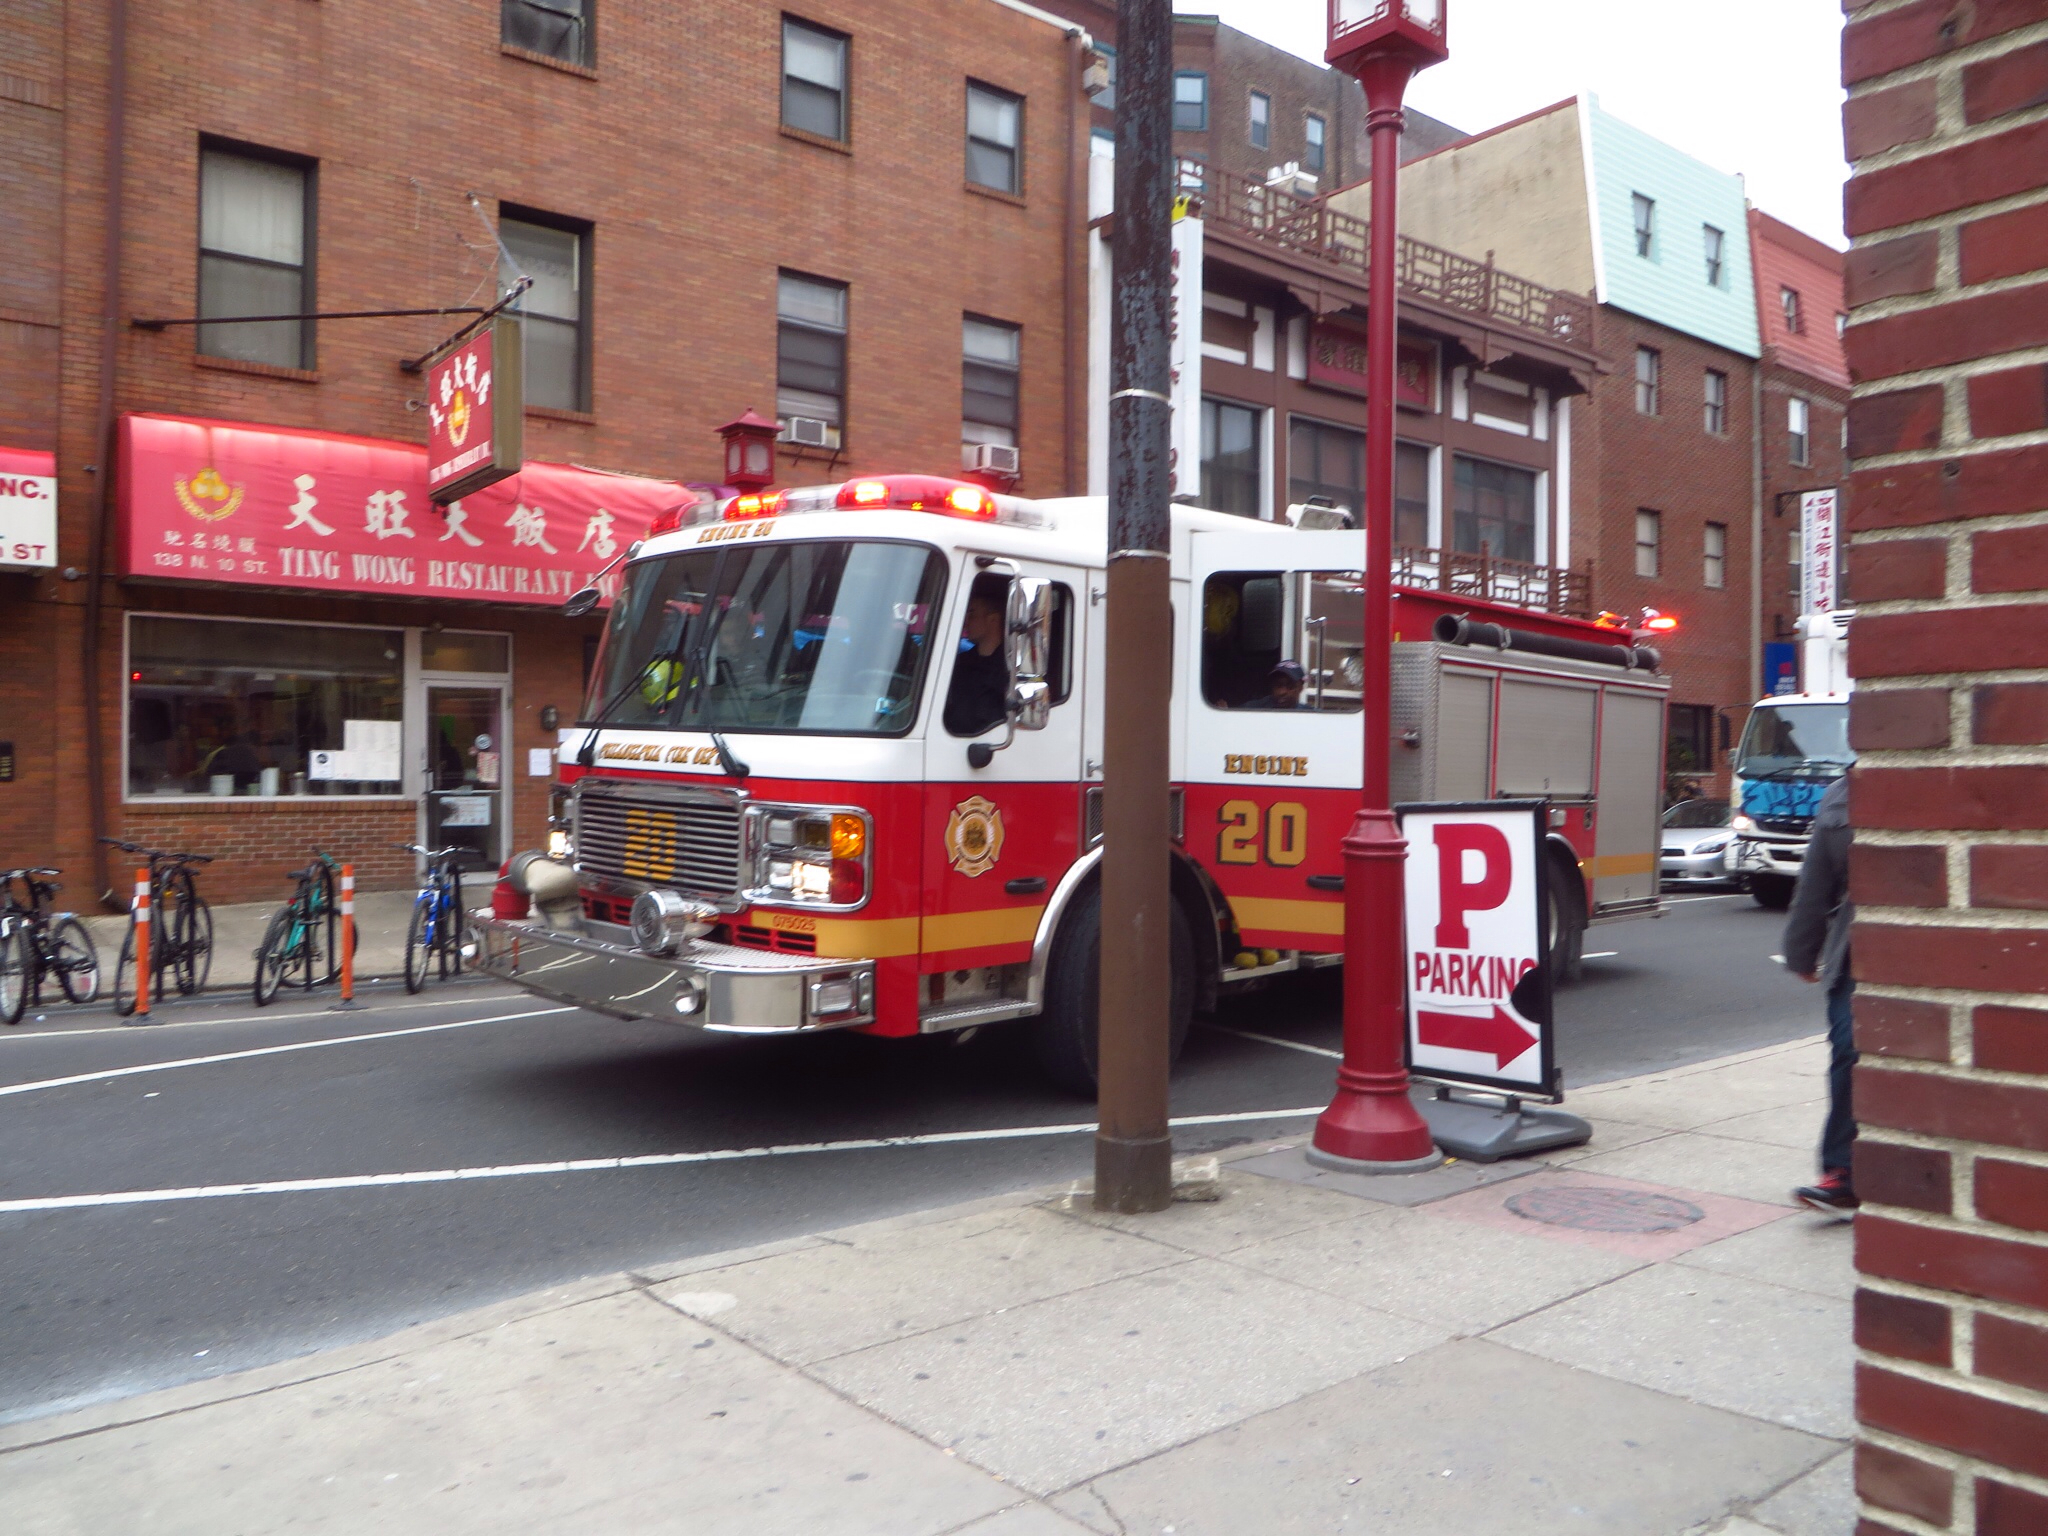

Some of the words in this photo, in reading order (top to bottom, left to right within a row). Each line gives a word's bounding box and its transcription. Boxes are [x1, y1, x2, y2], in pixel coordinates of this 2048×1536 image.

[753, 520, 777, 538] 20
[13, 543, 47, 561] ST
[153, 552, 184, 568] 138
[217, 558, 236, 572] 10
[278, 547, 342, 581] TING
[352, 553, 416, 586] WONG
[427, 559, 574, 597] RESTAURANT
[1224, 754, 1309, 777] ENGINE
[1217, 799, 1308, 869] 20
[1432, 823, 1513, 950] P
[772, 914, 817, 932] 075025
